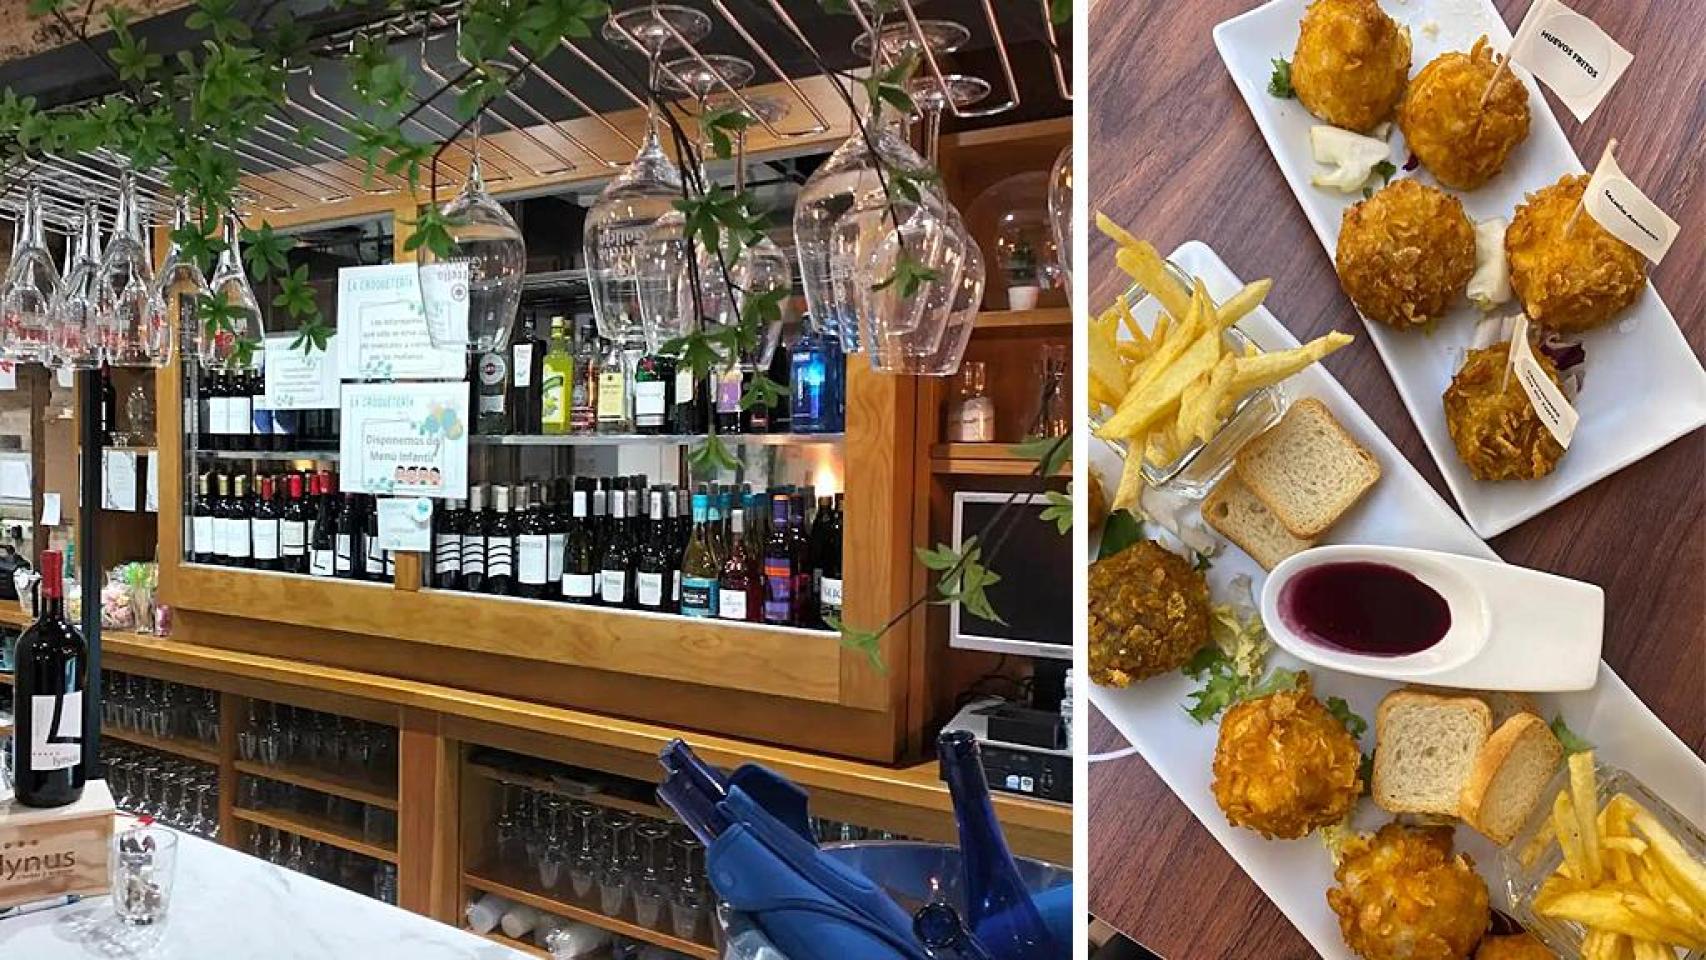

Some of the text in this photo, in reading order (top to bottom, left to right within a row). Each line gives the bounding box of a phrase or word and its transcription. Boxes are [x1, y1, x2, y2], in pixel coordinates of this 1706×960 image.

[1540, 29, 1599, 78] HUEVOS FRITOS
[366, 434, 424, 448] Disponemos
